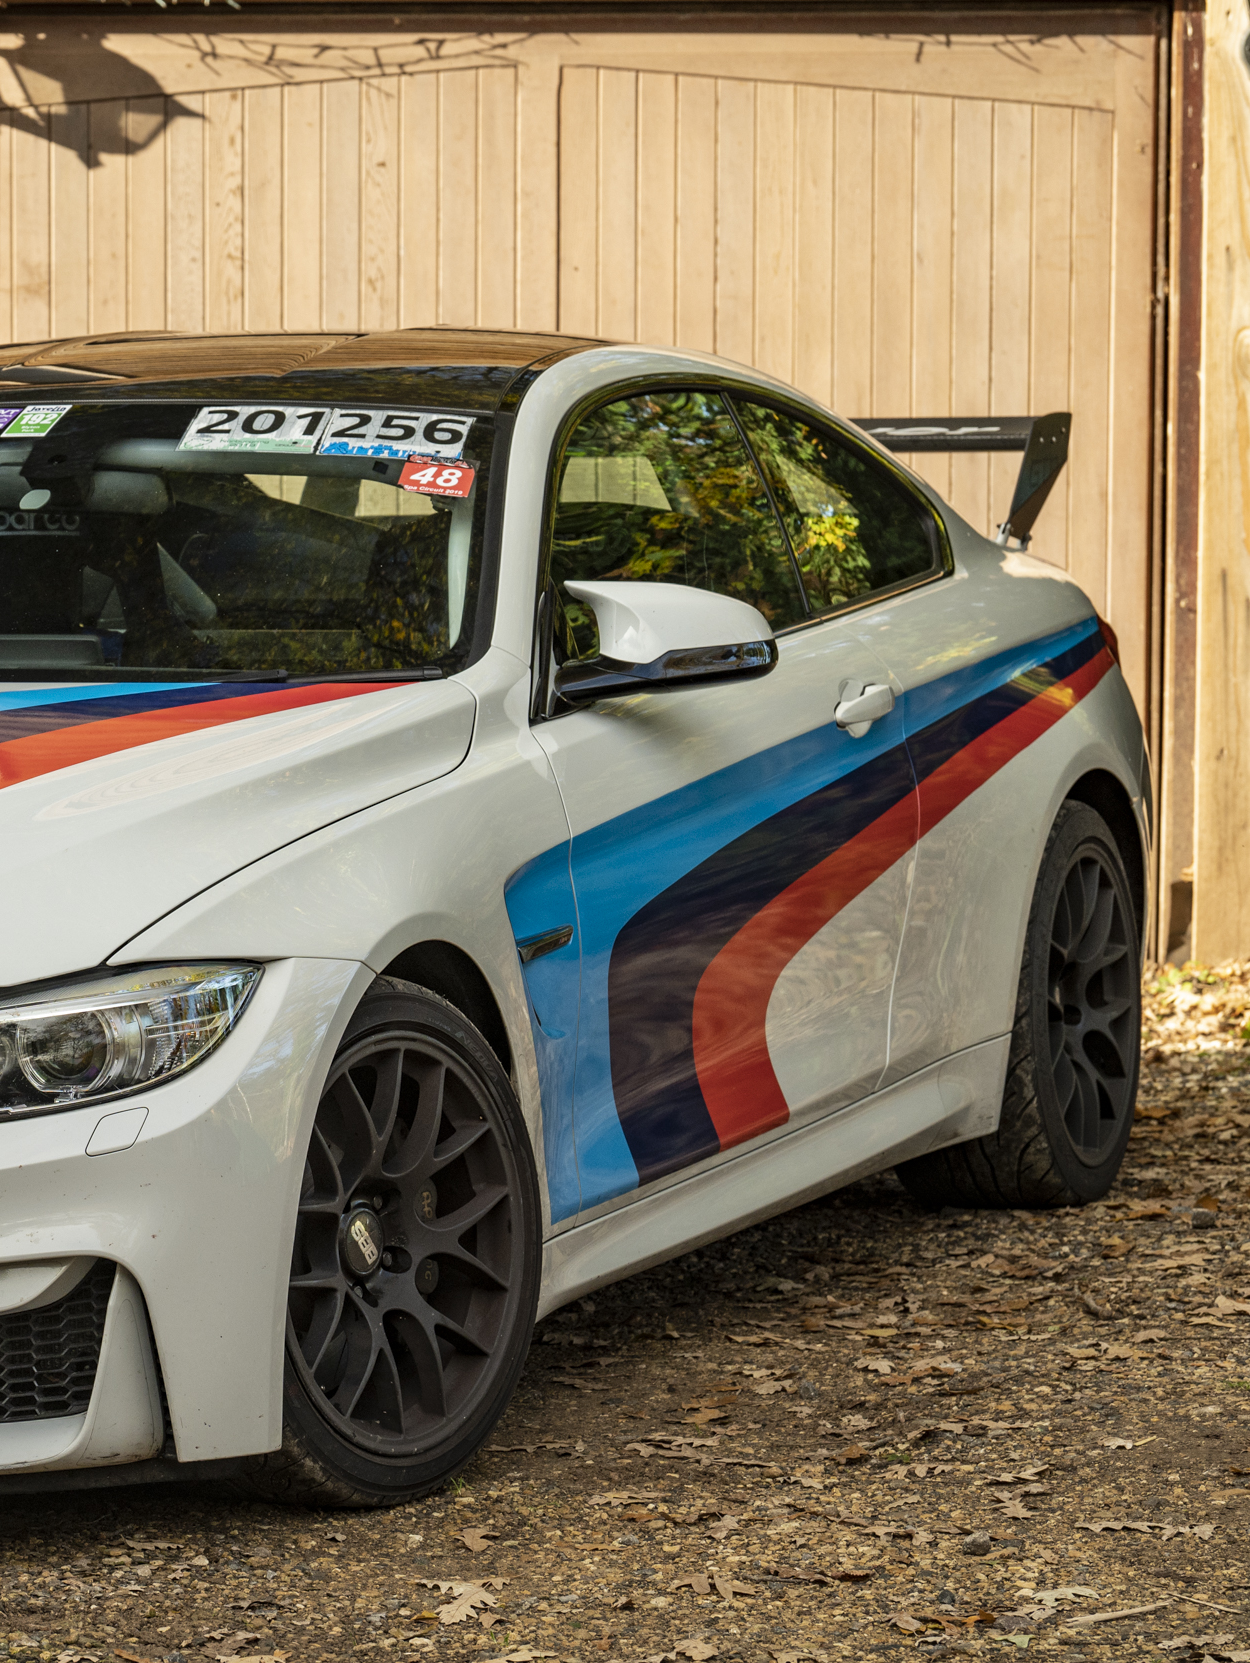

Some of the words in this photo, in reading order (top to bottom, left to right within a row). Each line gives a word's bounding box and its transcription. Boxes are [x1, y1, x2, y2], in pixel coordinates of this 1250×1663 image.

[20, 413, 59, 425] 192
[195, 409, 326, 436] 201
[330, 412, 467, 445] 256
[409, 466, 463, 487] 48
[419, 485, 445, 493] Circuit
[350, 1220, 379, 1266] BBS
